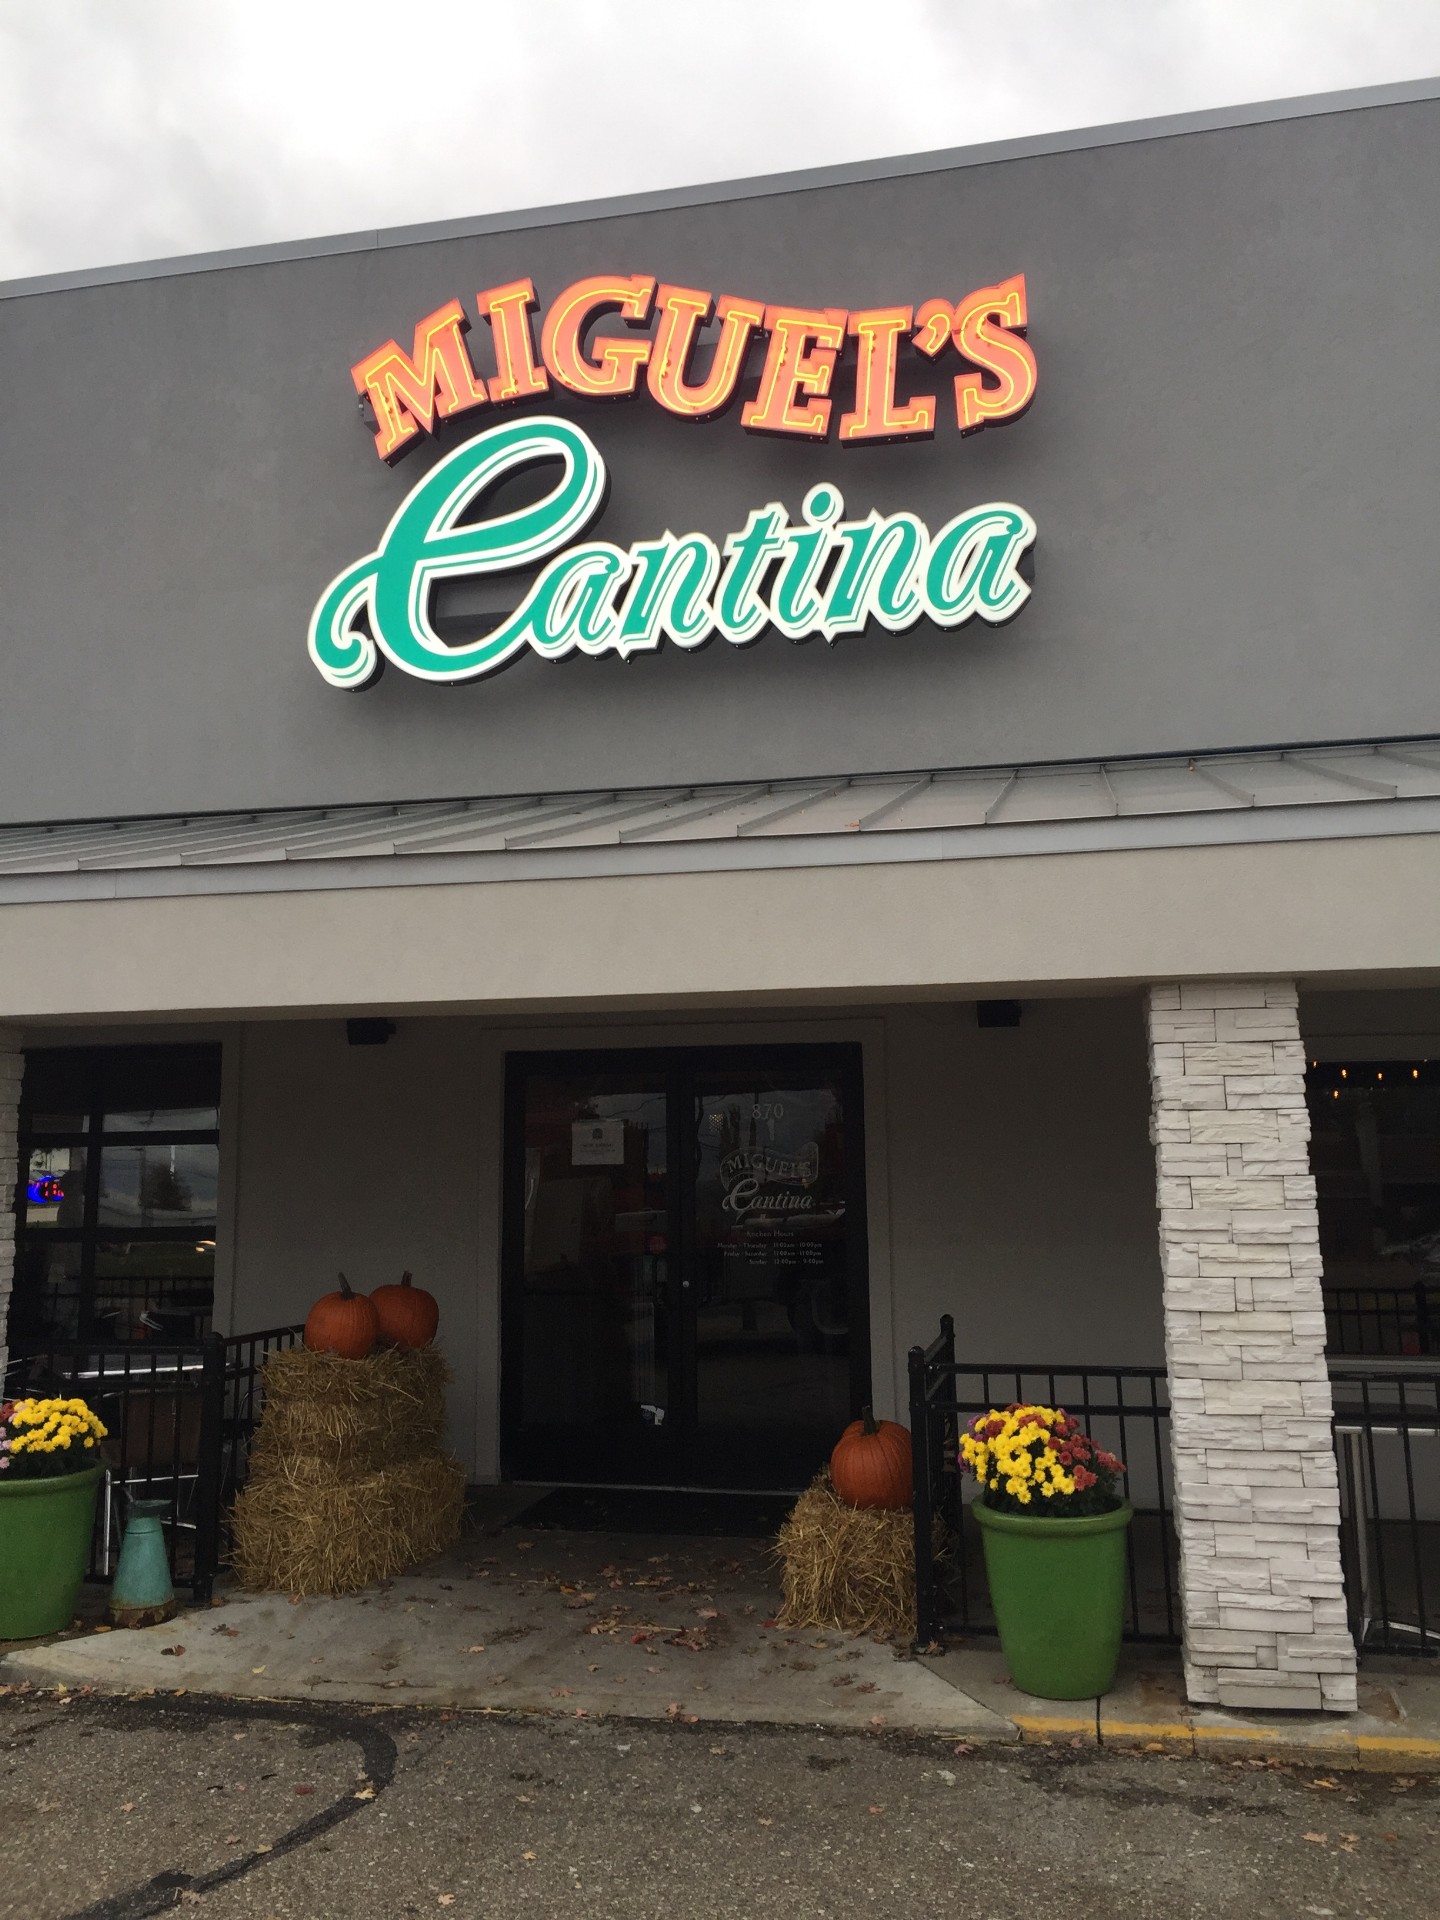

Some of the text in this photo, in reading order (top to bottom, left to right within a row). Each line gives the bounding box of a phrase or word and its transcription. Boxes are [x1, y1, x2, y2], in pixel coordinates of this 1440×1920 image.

[350, 273, 1038, 464] MIGUEL'S
[307, 415, 1037, 689] Cantina
[752, 1103, 784, 1120] 870
[722, 1178, 813, 1211] Cantina
